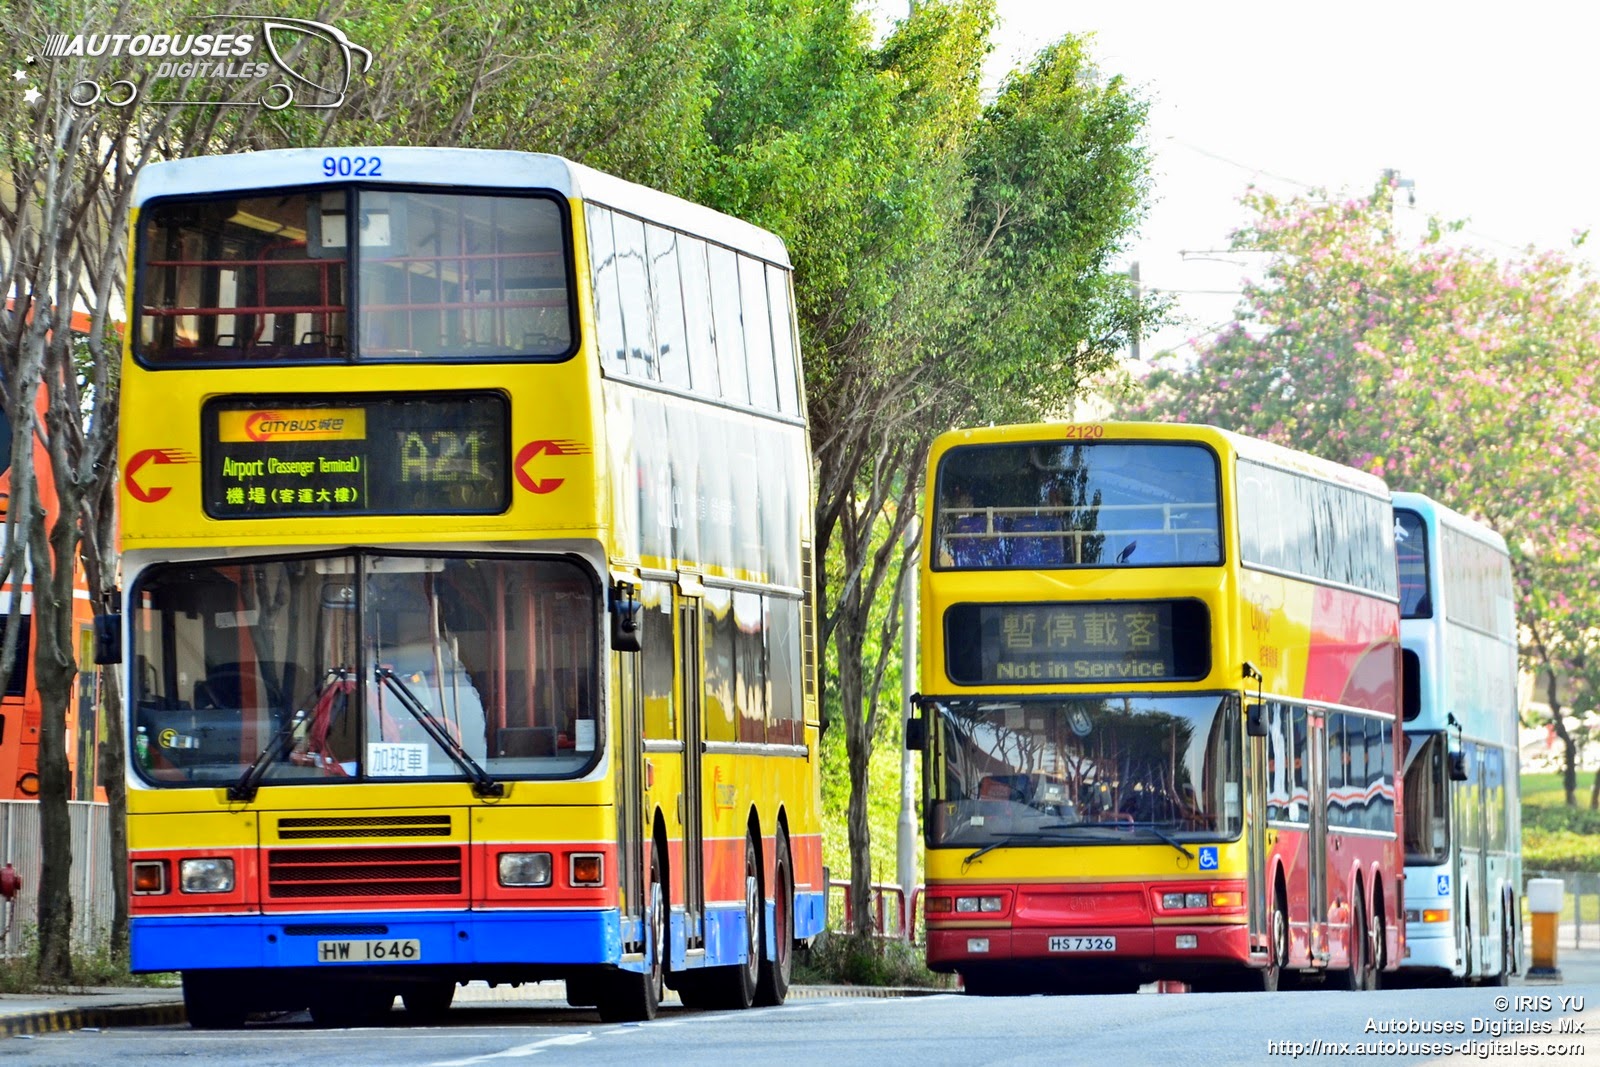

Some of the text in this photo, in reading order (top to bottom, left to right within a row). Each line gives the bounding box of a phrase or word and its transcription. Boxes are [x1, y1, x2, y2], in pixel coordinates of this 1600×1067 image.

[323, 156, 382, 177] 9022
[259, 420, 317, 433] CITYBUS
[1066, 425, 1103, 439] 2120
[401, 431, 482, 482] A21
[222, 457, 263, 480] Airport
[1003, 612, 1158, 649] 暫停載客
[996, 658, 1165, 680] Not in Service
[372, 747, 423, 772] 加班車
[323, 941, 415, 960] HW 1646
[1051, 938, 1113, 950] HS 7326
